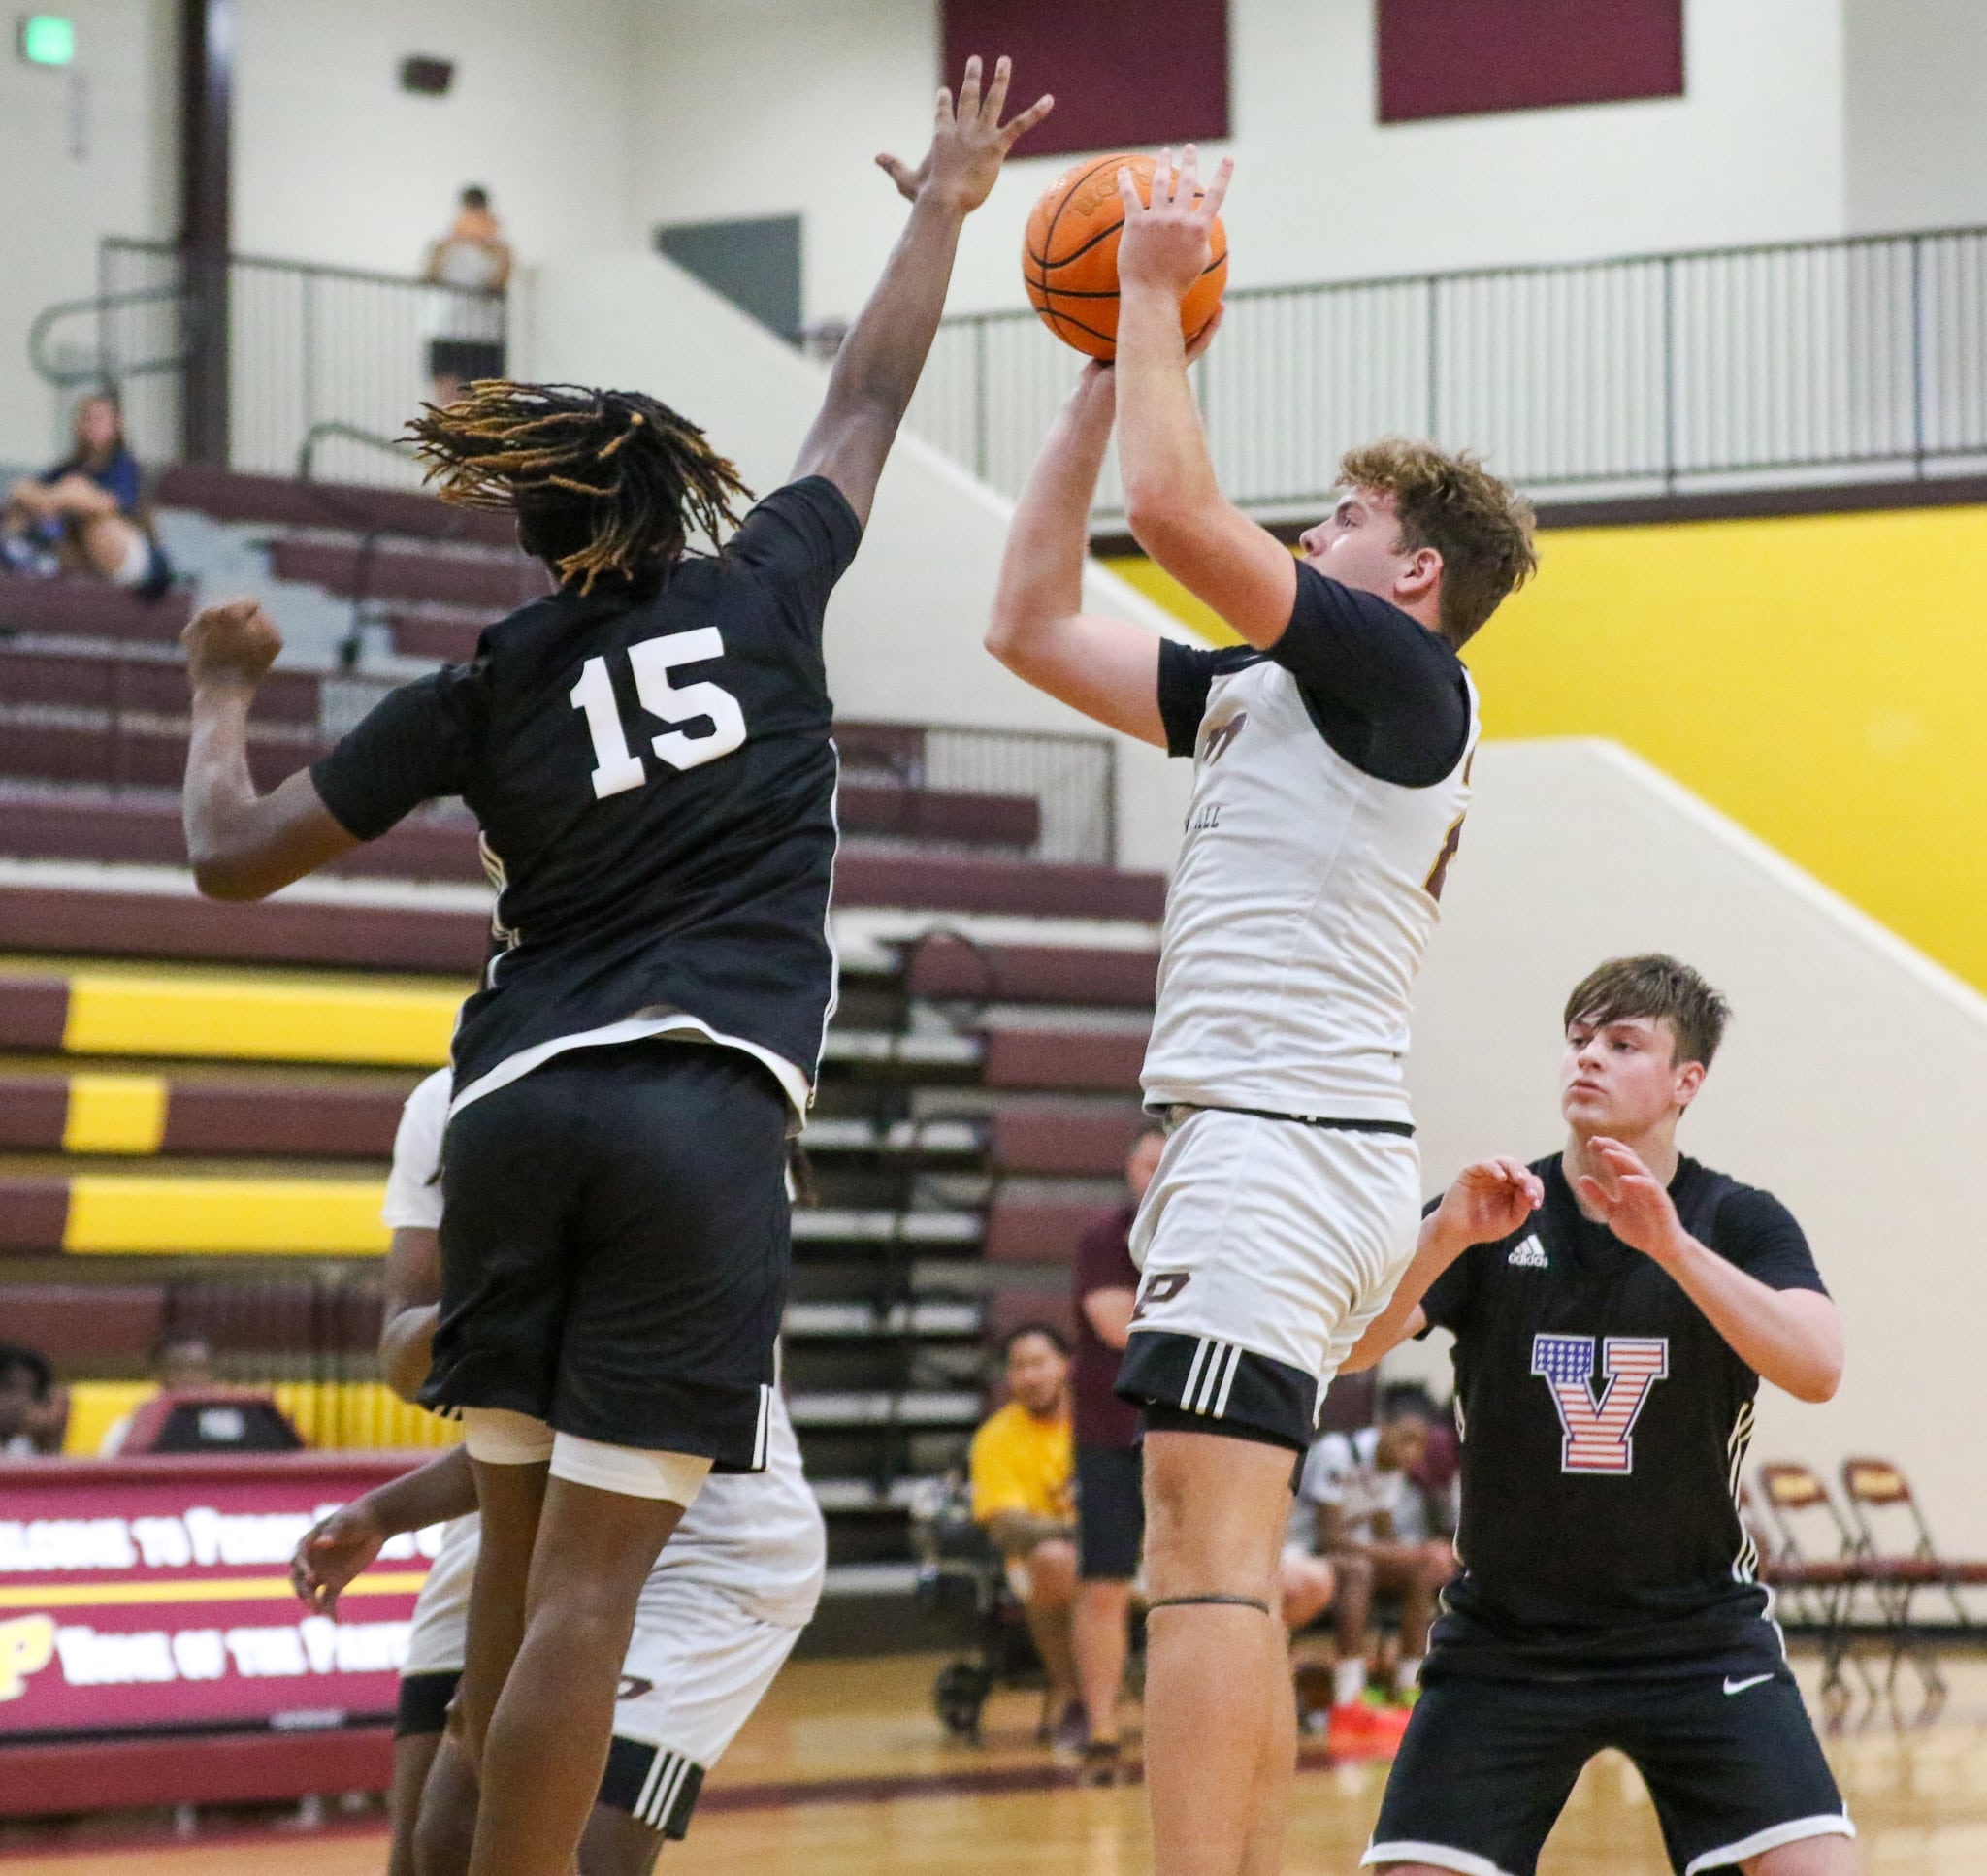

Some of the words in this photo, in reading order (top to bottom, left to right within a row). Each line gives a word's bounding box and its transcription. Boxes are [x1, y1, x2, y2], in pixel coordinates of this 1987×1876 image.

[570, 626, 747, 799] 15
[1507, 1251, 1548, 1269] adidas
[1131, 1272, 1191, 1323] P
